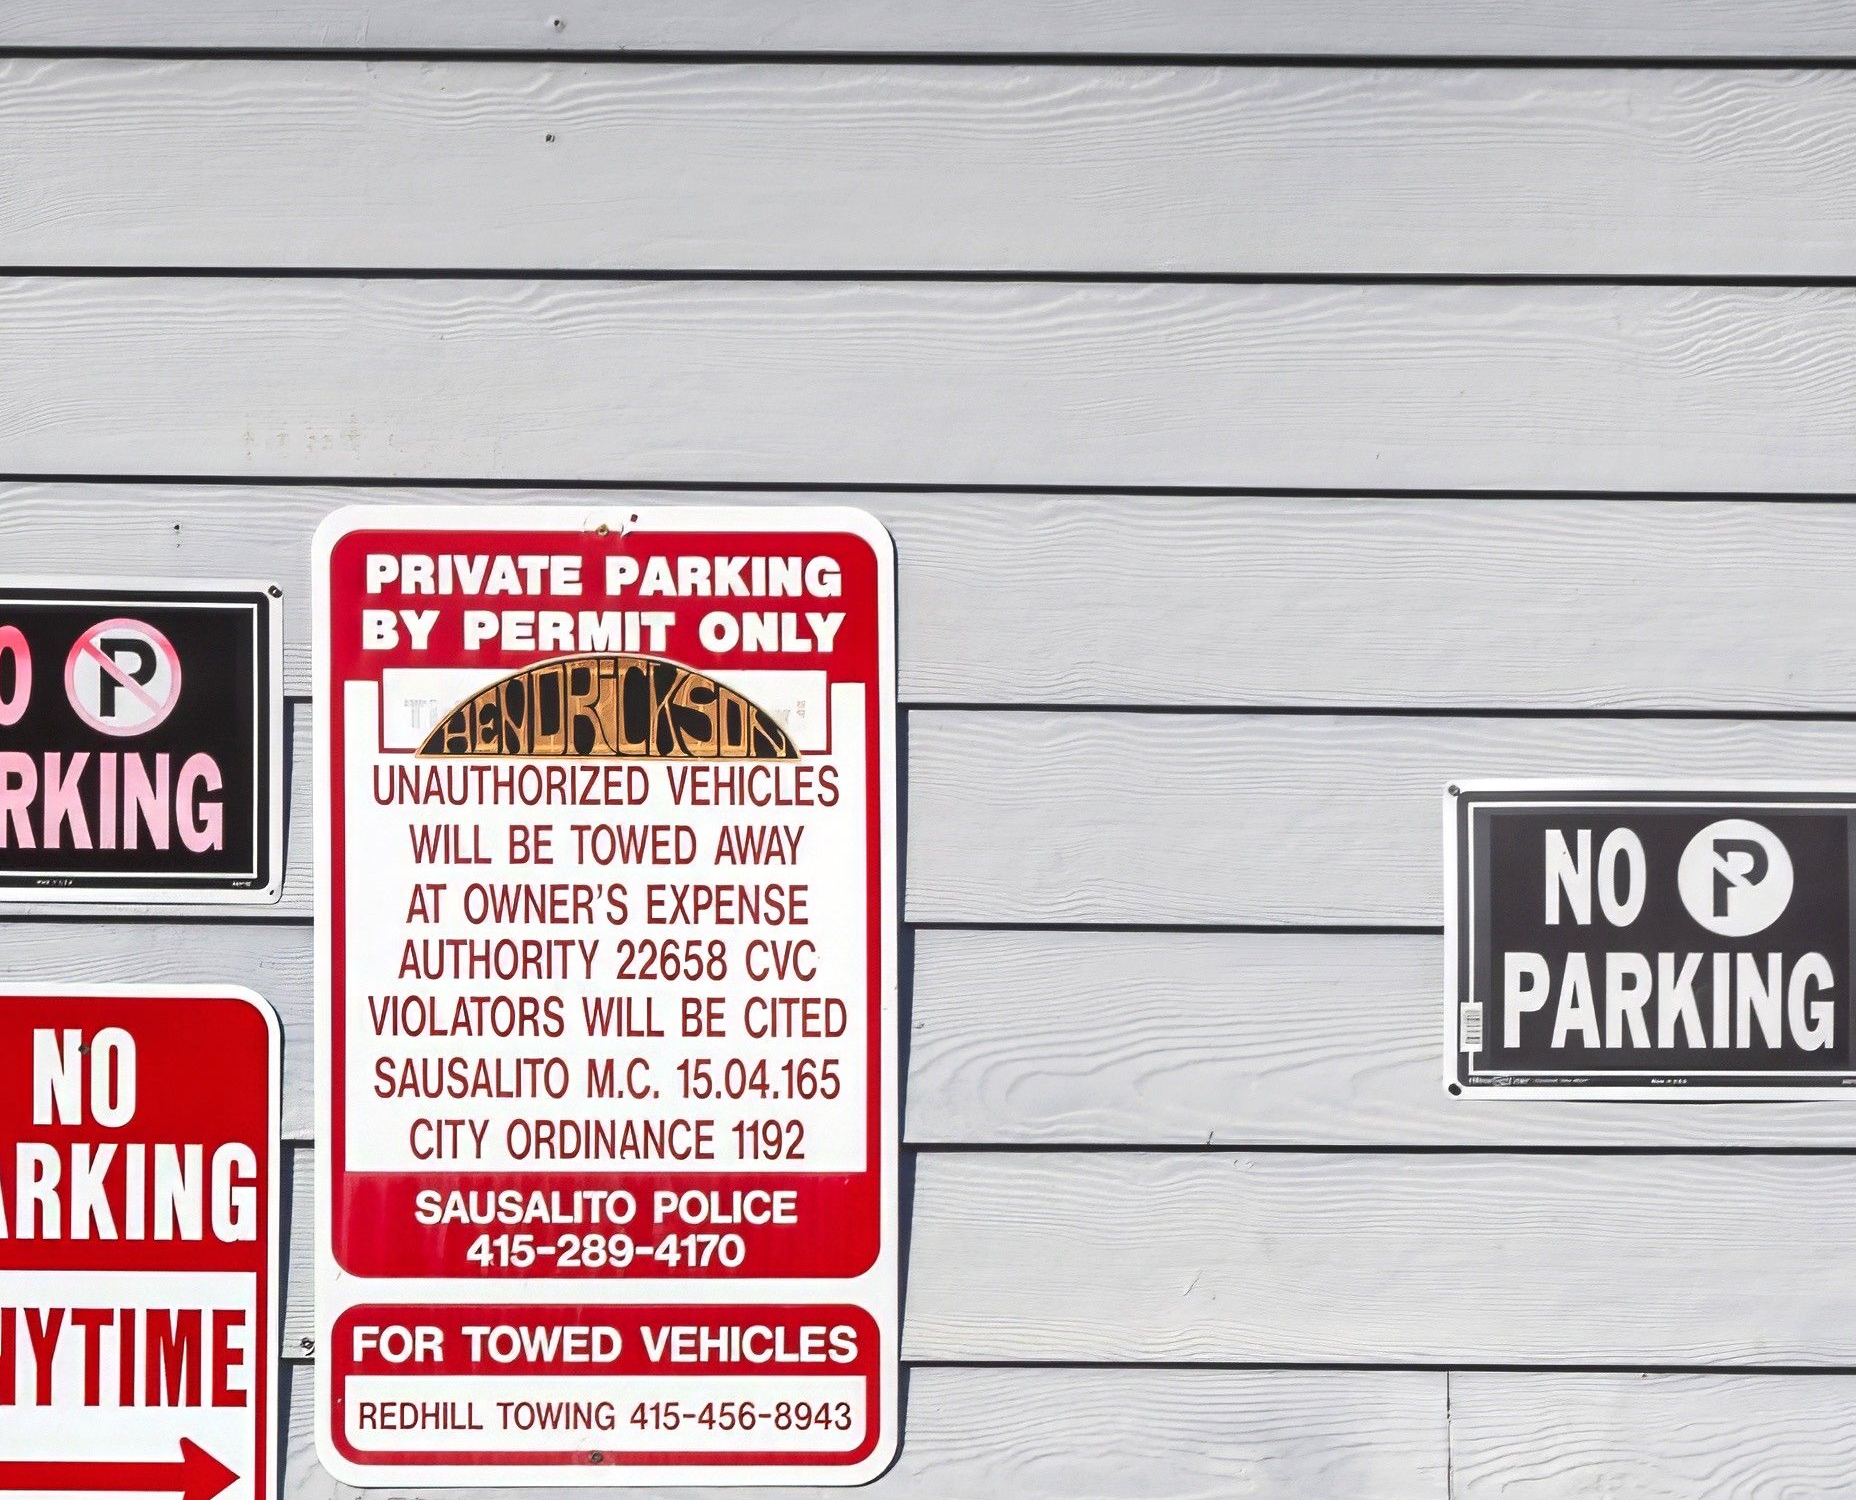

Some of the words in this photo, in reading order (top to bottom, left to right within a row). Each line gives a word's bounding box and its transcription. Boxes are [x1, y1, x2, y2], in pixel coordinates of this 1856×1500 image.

[367, 554, 582, 595] PRIVATE
[606, 556, 841, 597] PARKING
[363, 610, 440, 650] BY
[464, 611, 675, 652] PERMIT
[699, 611, 845, 652] ONLY
[374, 765, 649, 805] UNAUTHORIZED
[667, 765, 839, 806] VEHICLES
[410, 825, 491, 864] WILL
[510, 825, 553, 864] BE
[571, 824, 696, 865] TOWED
[715, 826, 804, 865] AWAY
[1546, 828, 1646, 927] NO
[407, 884, 446, 923] AT
[464, 883, 627, 925] OWNER'S
[647, 884, 808, 925] EXPENSE
[399, 939, 599, 980] AUTHORITY
[617, 939, 727, 981] 22658
[746, 940, 816, 981] CVC
[368, 995, 564, 1037] VIOLATORS
[582, 997, 664, 1037] WILL
[682, 998, 725, 1037] BE
[745, 997, 846, 1038] CITED
[1504, 952, 1834, 1051] PARKING
[34, 1027, 136, 1127] NO
[375, 1057, 568, 1098] SAUSALITO
[588, 1058, 658, 1099] M.C.
[677, 1058, 840, 1099] 15.04.165
[410, 1119, 489, 1159] CITY
[507, 1119, 714, 1160] ORDINANCE
[732, 1120, 804, 1160] 1192
[415, 1190, 636, 1224] SAUSALITO
[654, 1190, 797, 1224] POLICE
[467, 1234, 745, 1267] 415-289-4170
[354, 1326, 443, 1363] FOR
[462, 1325, 622, 1363] TOWED
[641, 1325, 857, 1363] VEHICLES
[360, 1402, 483, 1429] REDHILL
[497, 1402, 614, 1430] TOWING
[631, 1402, 851, 1430] 415-456-8943
